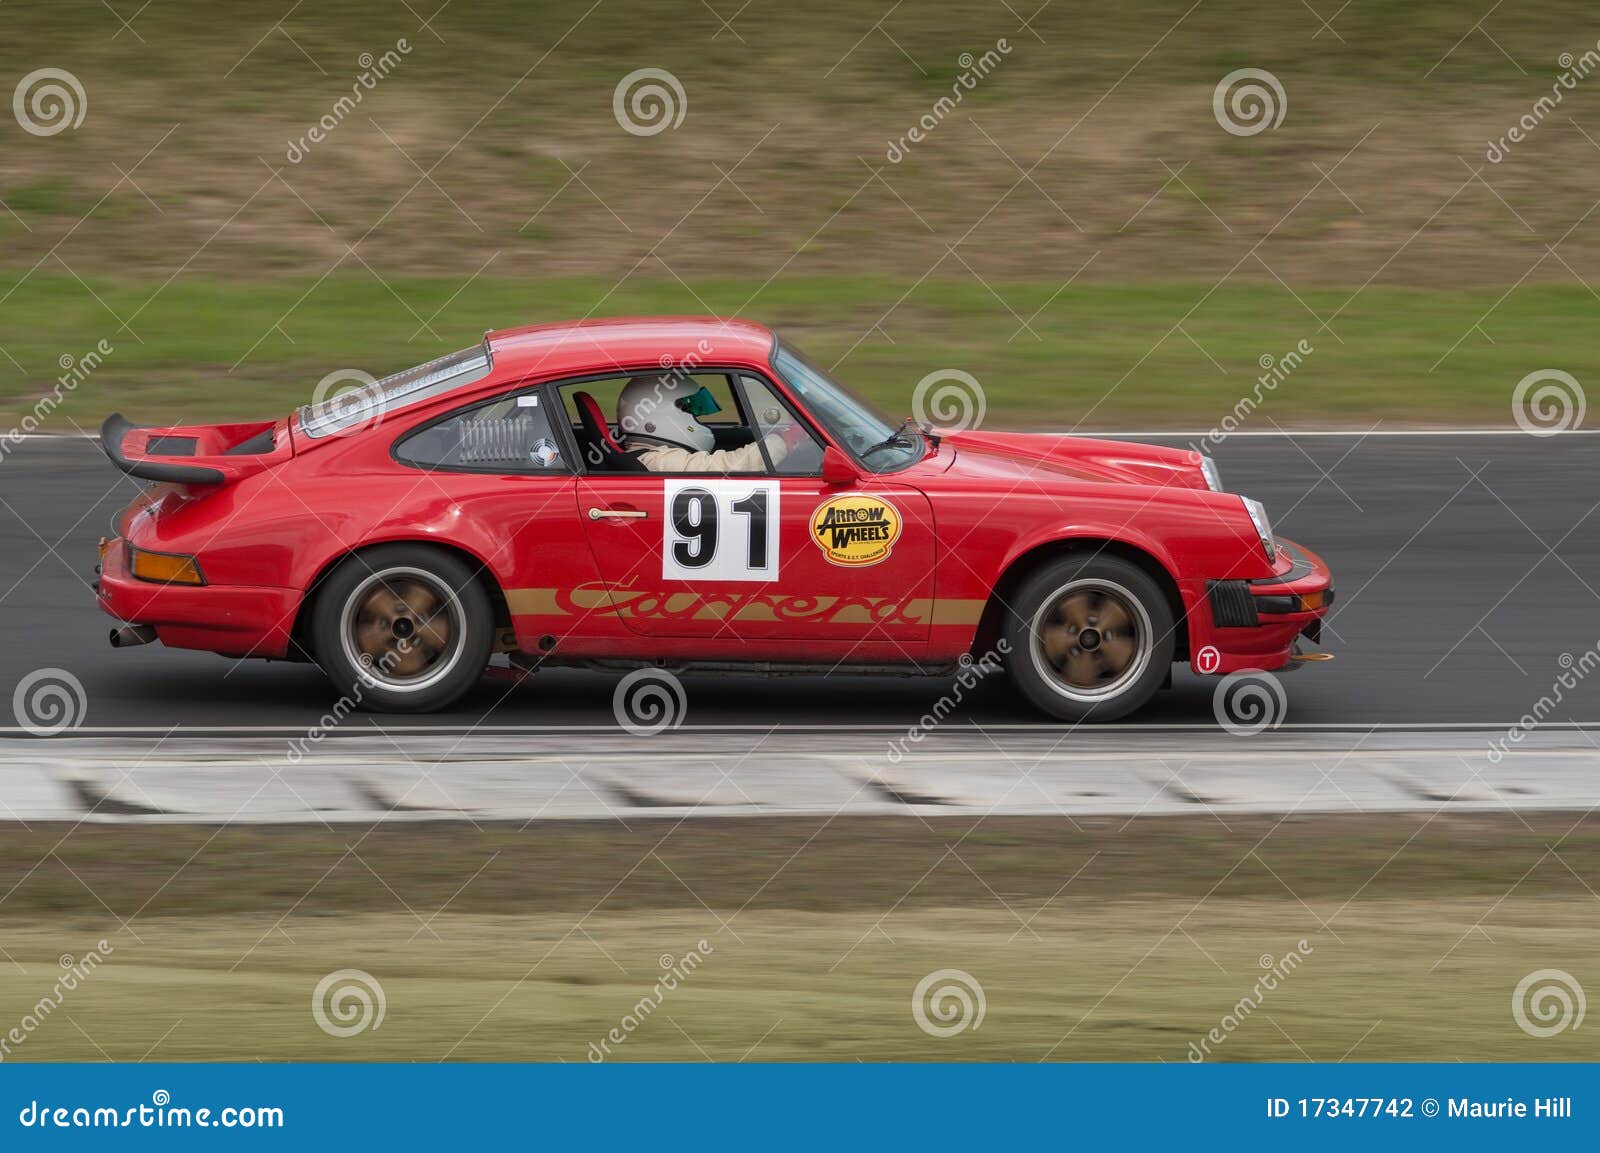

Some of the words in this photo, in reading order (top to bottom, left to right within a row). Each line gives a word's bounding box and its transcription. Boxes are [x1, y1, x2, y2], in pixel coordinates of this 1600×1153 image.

[670, 486, 769, 571] 91
[817, 507, 886, 536] ARROW
[832, 526, 890, 549] WHEELS
[554, 574, 922, 624] Carrera
